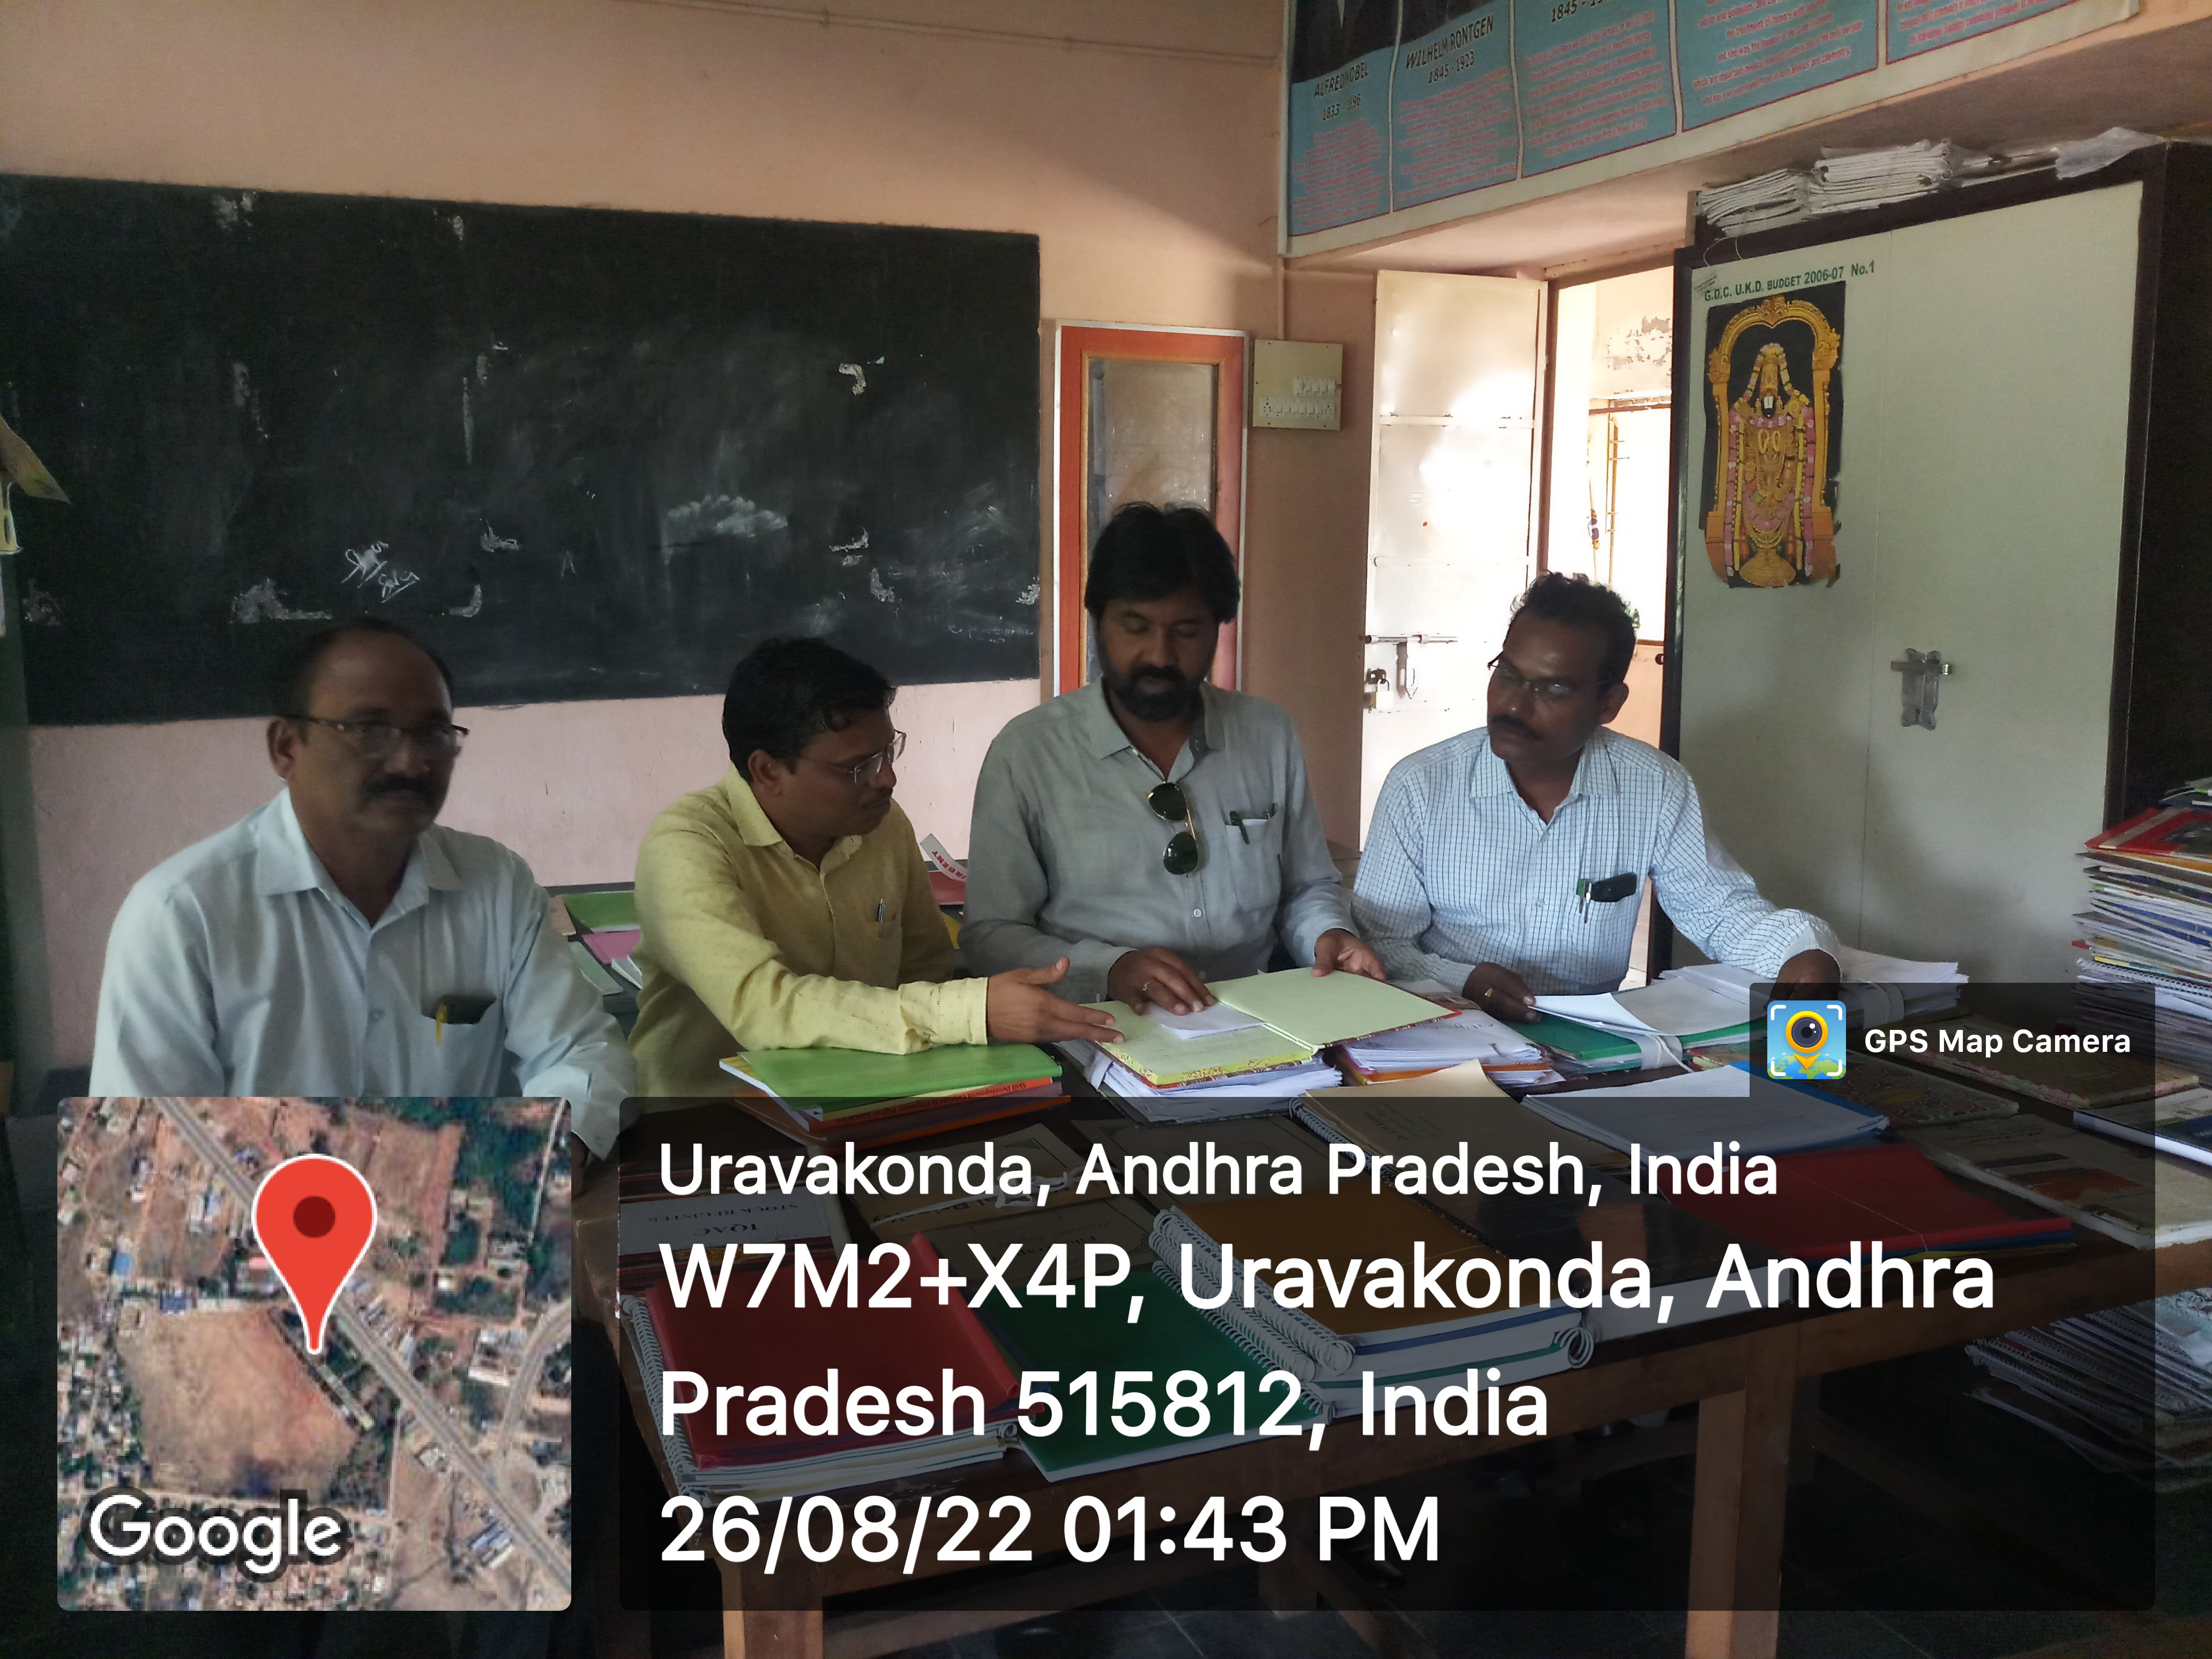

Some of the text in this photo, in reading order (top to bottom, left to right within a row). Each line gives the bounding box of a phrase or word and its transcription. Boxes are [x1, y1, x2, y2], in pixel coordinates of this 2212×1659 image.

[1551, 0, 1578, 23] 1845
[1406, 14, 1494, 69] WILHELM RONTGEN
[1428, 63, 1449, 84] 1845
[1456, 49, 1475, 72] 1923
[1314, 73, 1344, 98] ALFRED
[1321, 103, 1340, 121] 1833
[1705, 286, 1732, 301] G.D.C.
[1735, 280, 1763, 295] U.K.D.
[1767, 274, 1802, 290] BUDGET
[1804, 266, 1844, 285] 2006-07
[967, 1083, 1011, 1100] Development
[1012, 1082, 1026, 1091] Skill
[940, 1094, 967, 1104] Courses
[647, 1204, 798, 1223] STOCK REGISTER
[694, 1223, 757, 1236] IQAC
